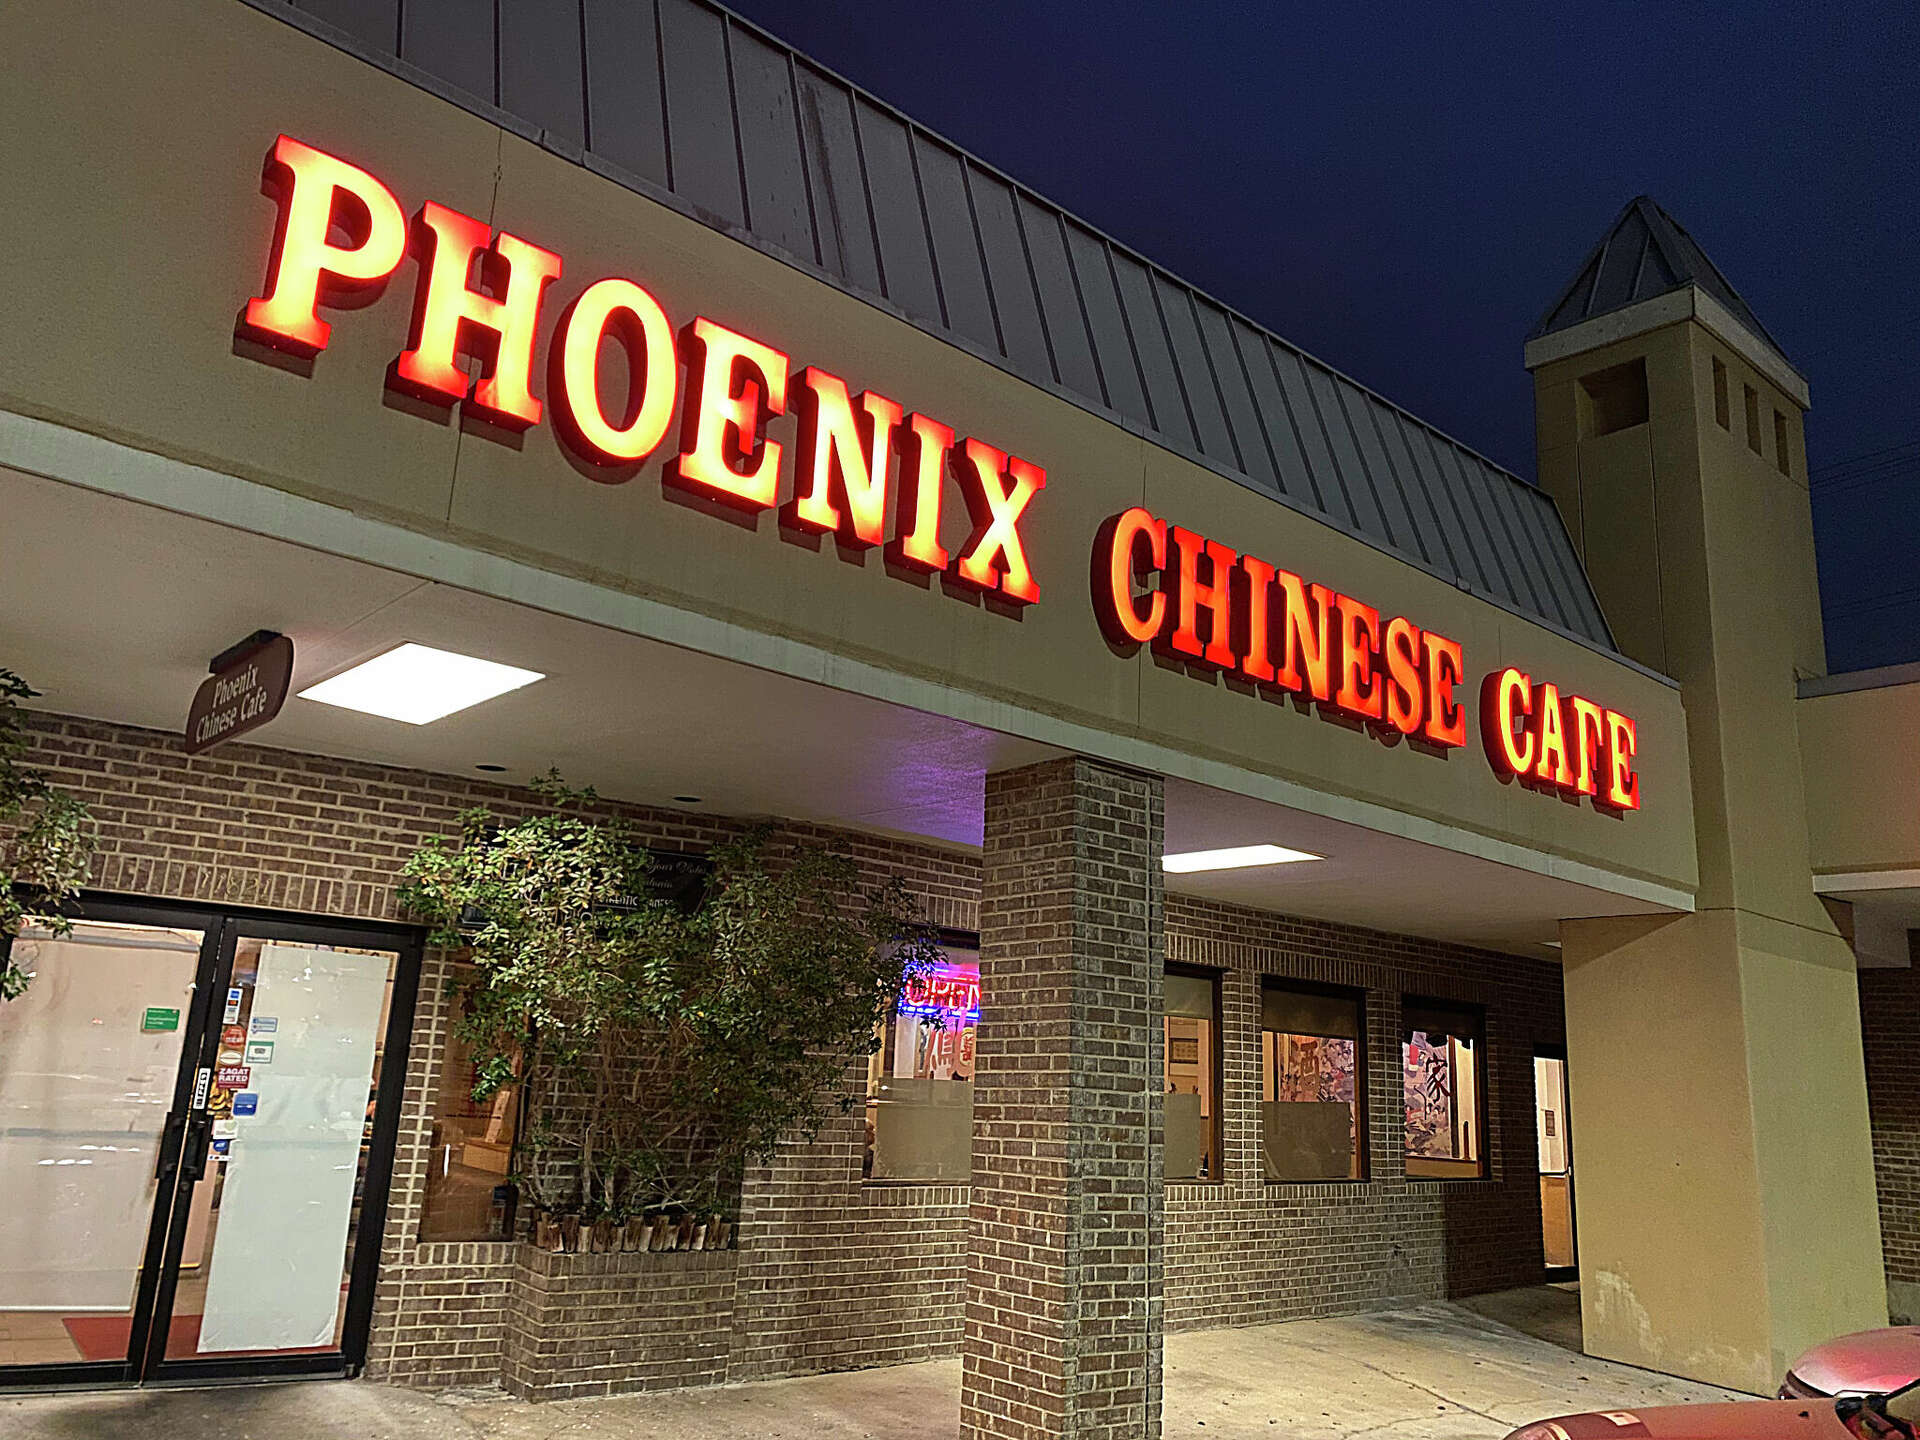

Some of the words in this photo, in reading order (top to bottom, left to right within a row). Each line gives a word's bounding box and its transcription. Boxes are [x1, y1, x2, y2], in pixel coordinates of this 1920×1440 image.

[244, 132, 1048, 606] PHOENIX
[1108, 506, 1467, 748] CHINESE
[1497, 666, 1641, 811] CAFE
[212, 663, 259, 709] Phoenix
[196, 706, 238, 744] Chinese
[240, 686, 268, 721] Cafe
[218, 1074, 249, 1082] RATED
[220, 1067, 249, 1075] ZAGAT
